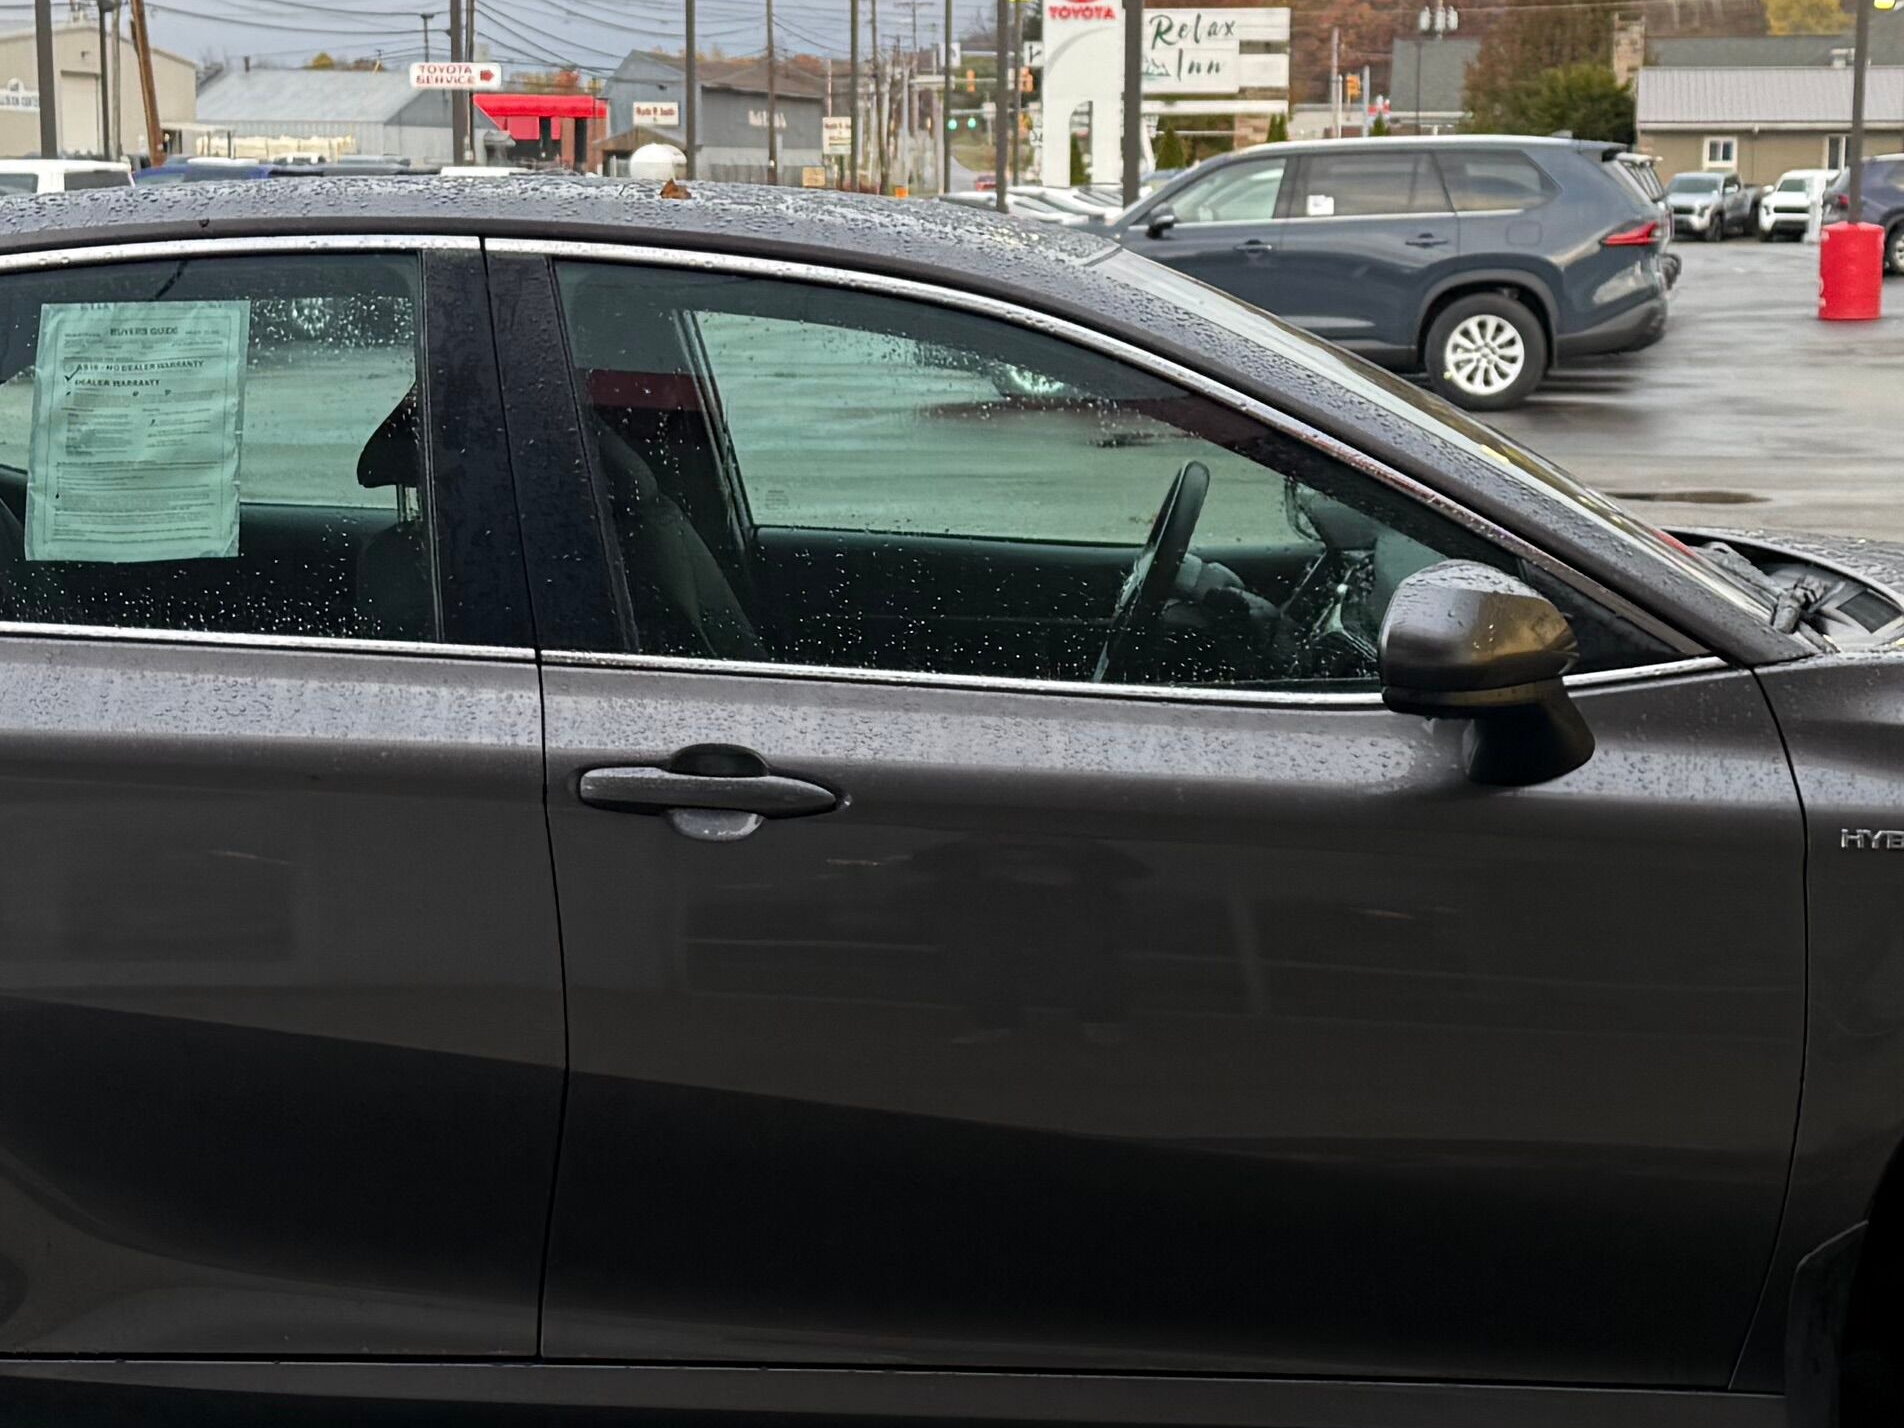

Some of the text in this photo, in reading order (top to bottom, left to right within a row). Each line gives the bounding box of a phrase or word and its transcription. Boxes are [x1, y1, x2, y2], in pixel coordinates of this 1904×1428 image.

[1049, 6, 1116, 20] TOYOTA
[1149, 13, 1236, 50] Relax
[418, 65, 473, 74] TOYOTA
[1177, 48, 1222, 81] Inn
